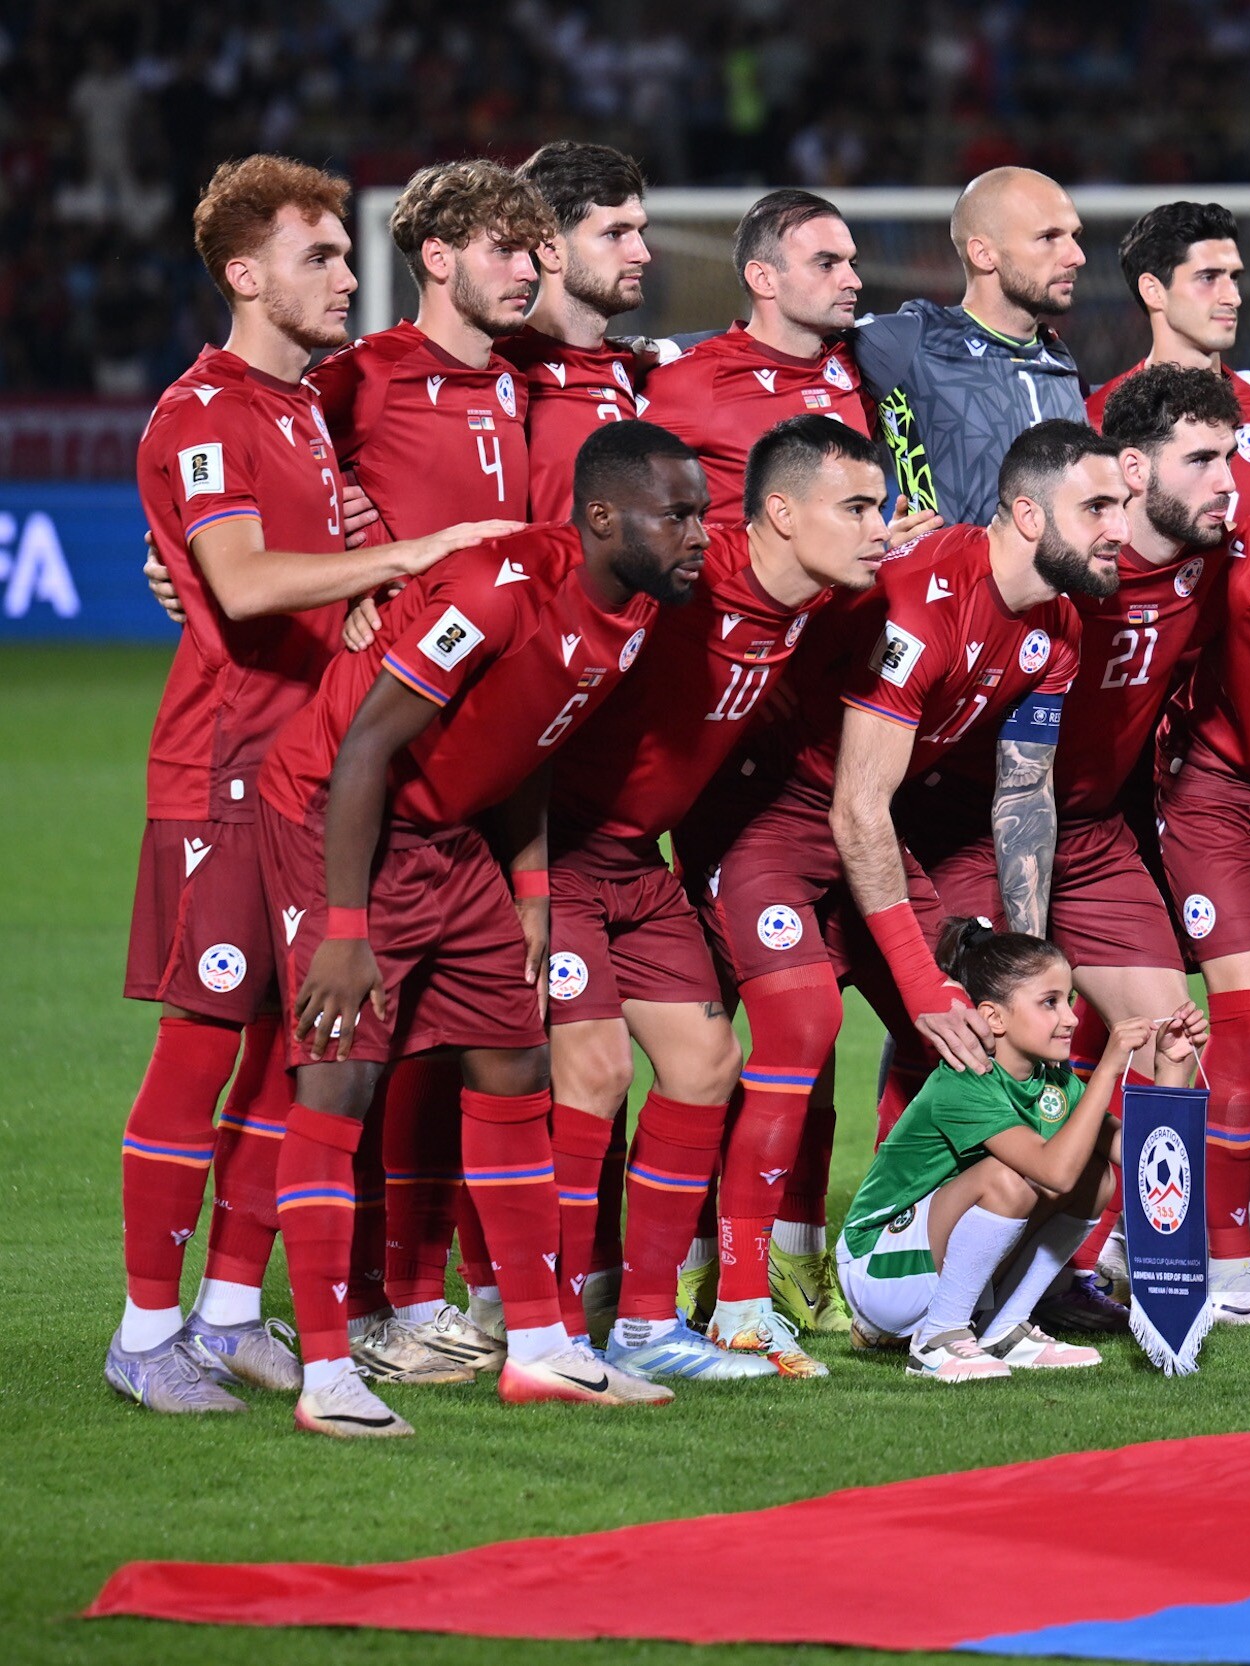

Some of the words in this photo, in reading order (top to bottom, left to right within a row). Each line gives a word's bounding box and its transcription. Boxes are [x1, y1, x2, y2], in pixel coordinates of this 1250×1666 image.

[476, 435, 504, 502] 4
[321, 468, 340, 535] 3
[1100, 627, 1158, 689] 21
[537, 693, 589, 747] 6
[704, 663, 769, 721] 10
[1144, 1129, 1181, 1155] FEDERATION
[1179, 1147, 1188, 1162] OF
[1133, 1271, 1155, 1280] ARMENIA
[1156, 1272, 1163, 1281] VS
[1182, 1273, 1204, 1282] IRELAND
